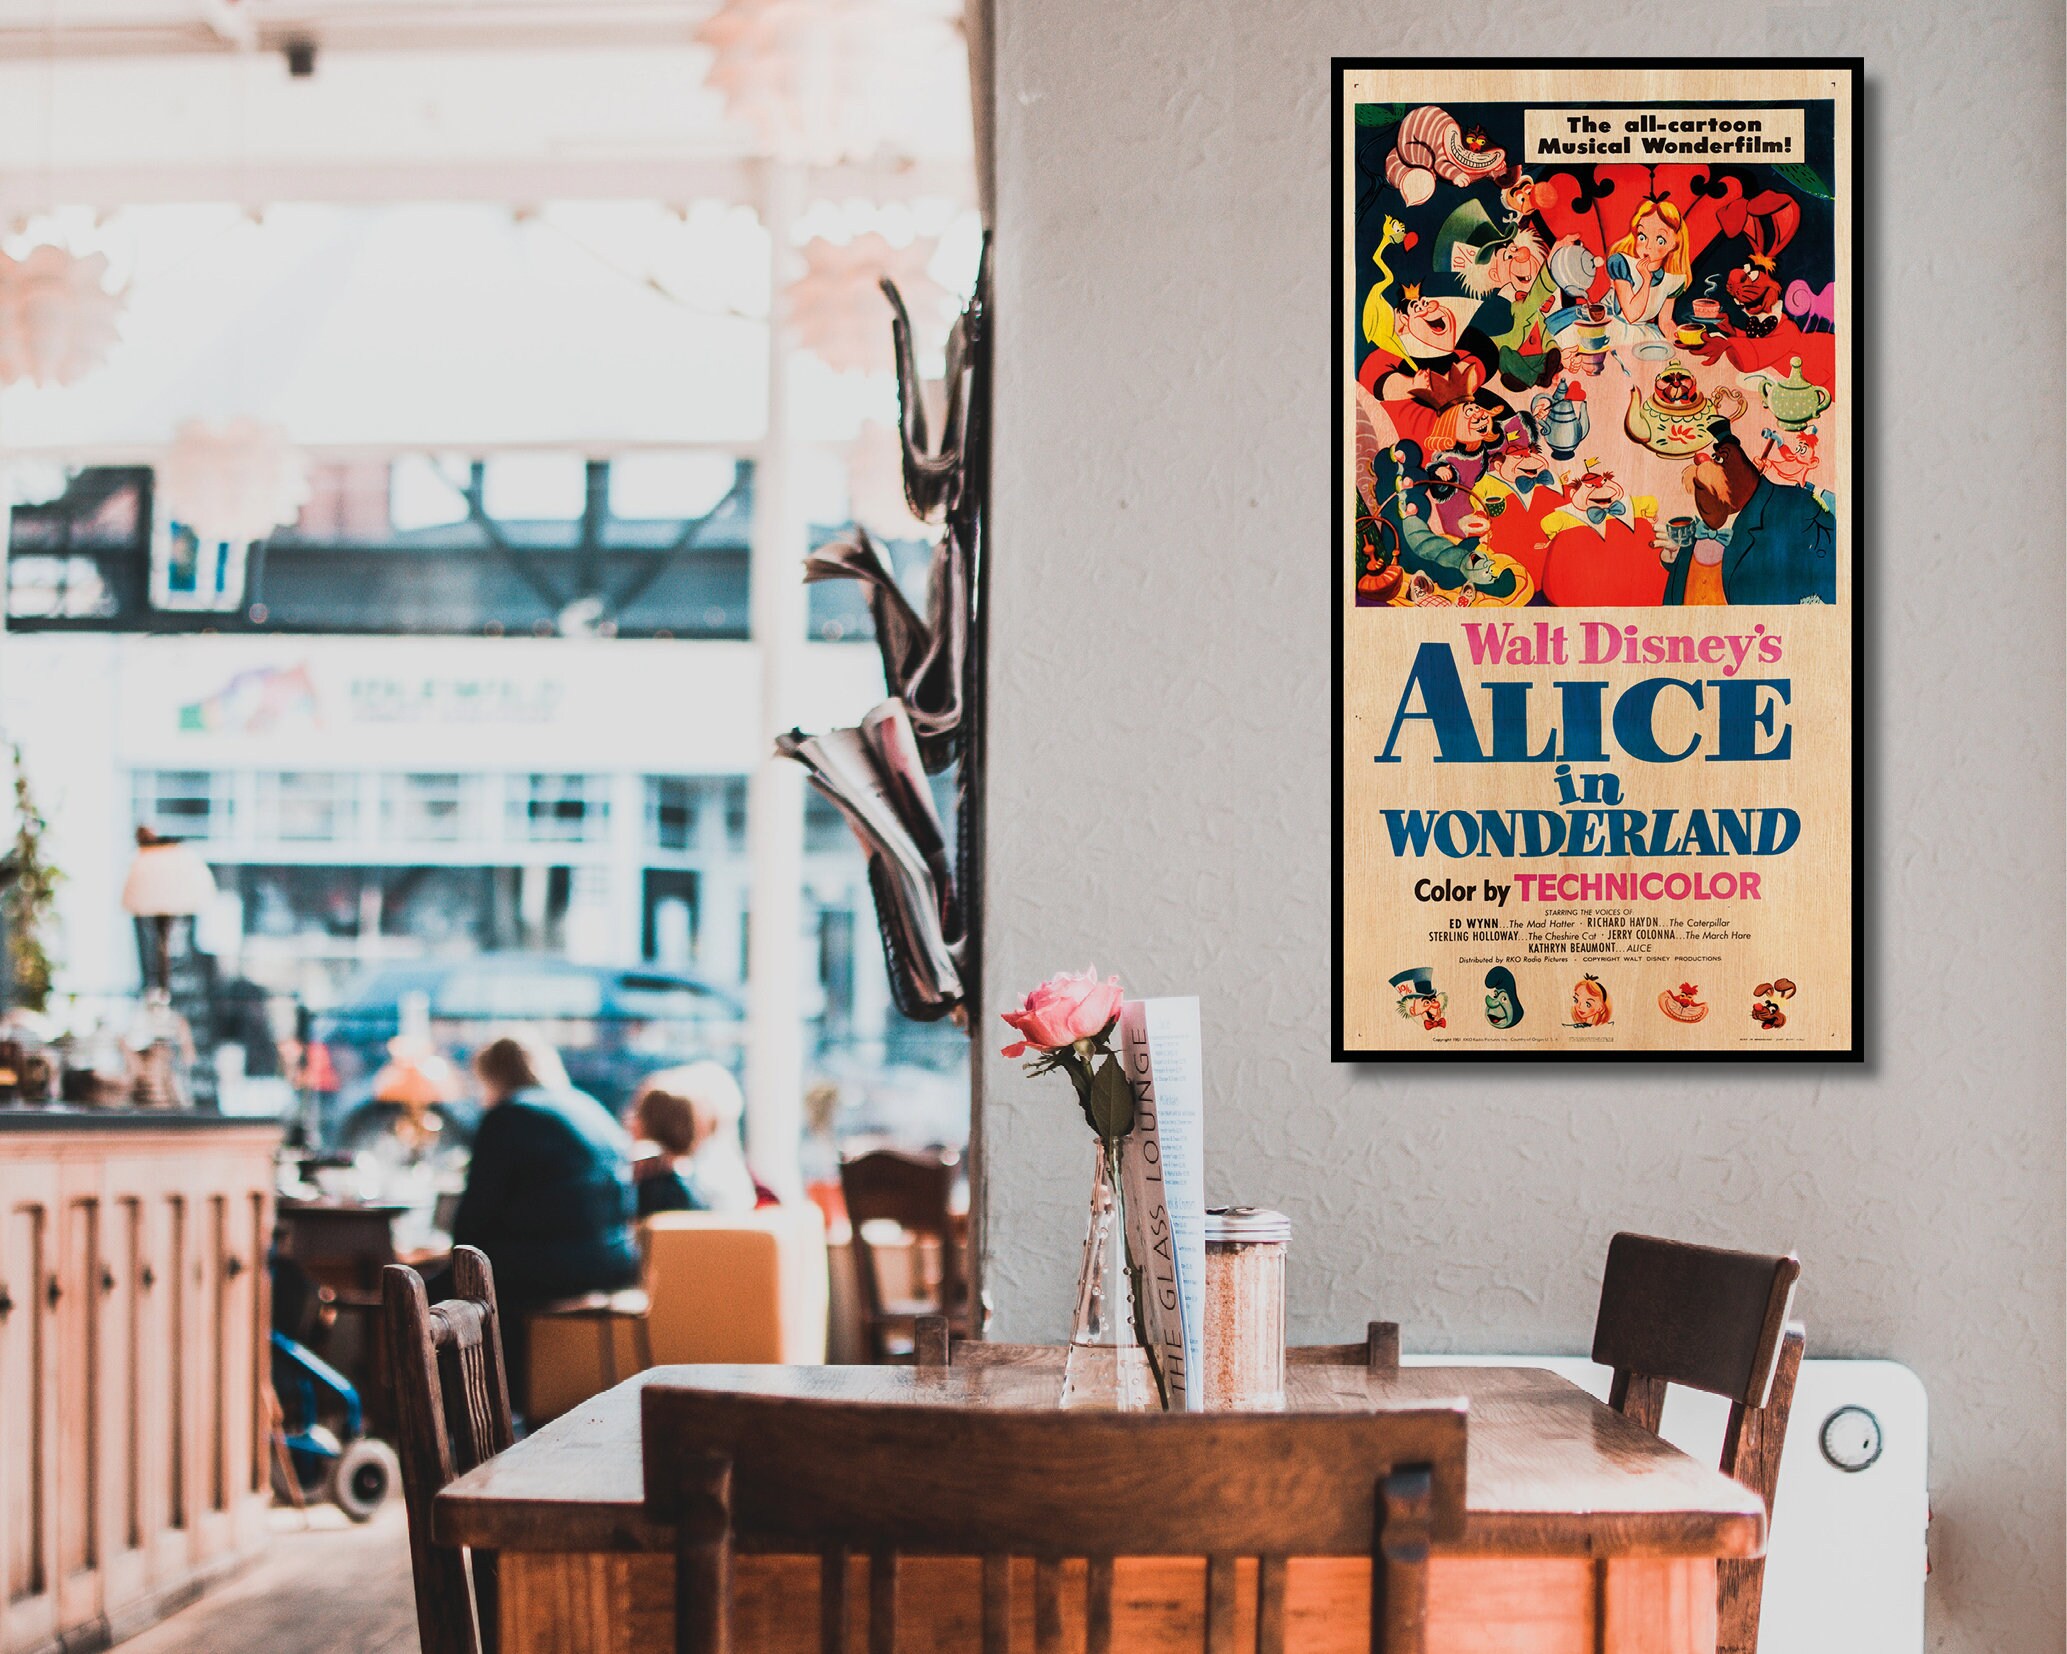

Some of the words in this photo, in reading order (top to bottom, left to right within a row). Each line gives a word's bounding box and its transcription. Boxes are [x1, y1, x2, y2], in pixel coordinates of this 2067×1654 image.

[1537, 136, 1631, 155] Musical
[1643, 136, 1792, 154] Wonderfilm!
[1567, 116, 1612, 133] The
[1625, 116, 1762, 132] all-cartoon
[1461, 622, 1569, 665] Walt
[1578, 622, 1782, 677] Disney's
[1374, 641, 1792, 763] ALICE
[1554, 763, 1624, 806] in
[1379, 807, 1801, 858] WONDERLAND
[1414, 878, 1476, 902] Color
[1484, 880, 1511, 907] by
[1514, 872, 1762, 901] TECHNICOLOR
[1429, 932, 1468, 941] STERLING
[1545, 932, 1579, 940] Cheshire
[1582, 932, 1596, 940] Cat
[1608, 930, 1632, 940] JERRY
[1702, 931, 1728, 939] March
[1731, 931, 1751, 939] Hare
[1450, 919, 1461, 928] ED
[1527, 920, 1546, 928] Mad
[1550, 919, 1575, 928] Hatter
[1587, 917, 1625, 927] RICHARD
[1687, 918, 1730, 928] Caterpillar
[1529, 943, 1566, 953] KATHRYN
[1627, 944, 1652, 952] ALICE
[1133, 1029, 1162, 1181] LOUNGE
[1149, 1205, 1177, 1310] GLASS
[1164, 1329, 1186, 1395] THE
